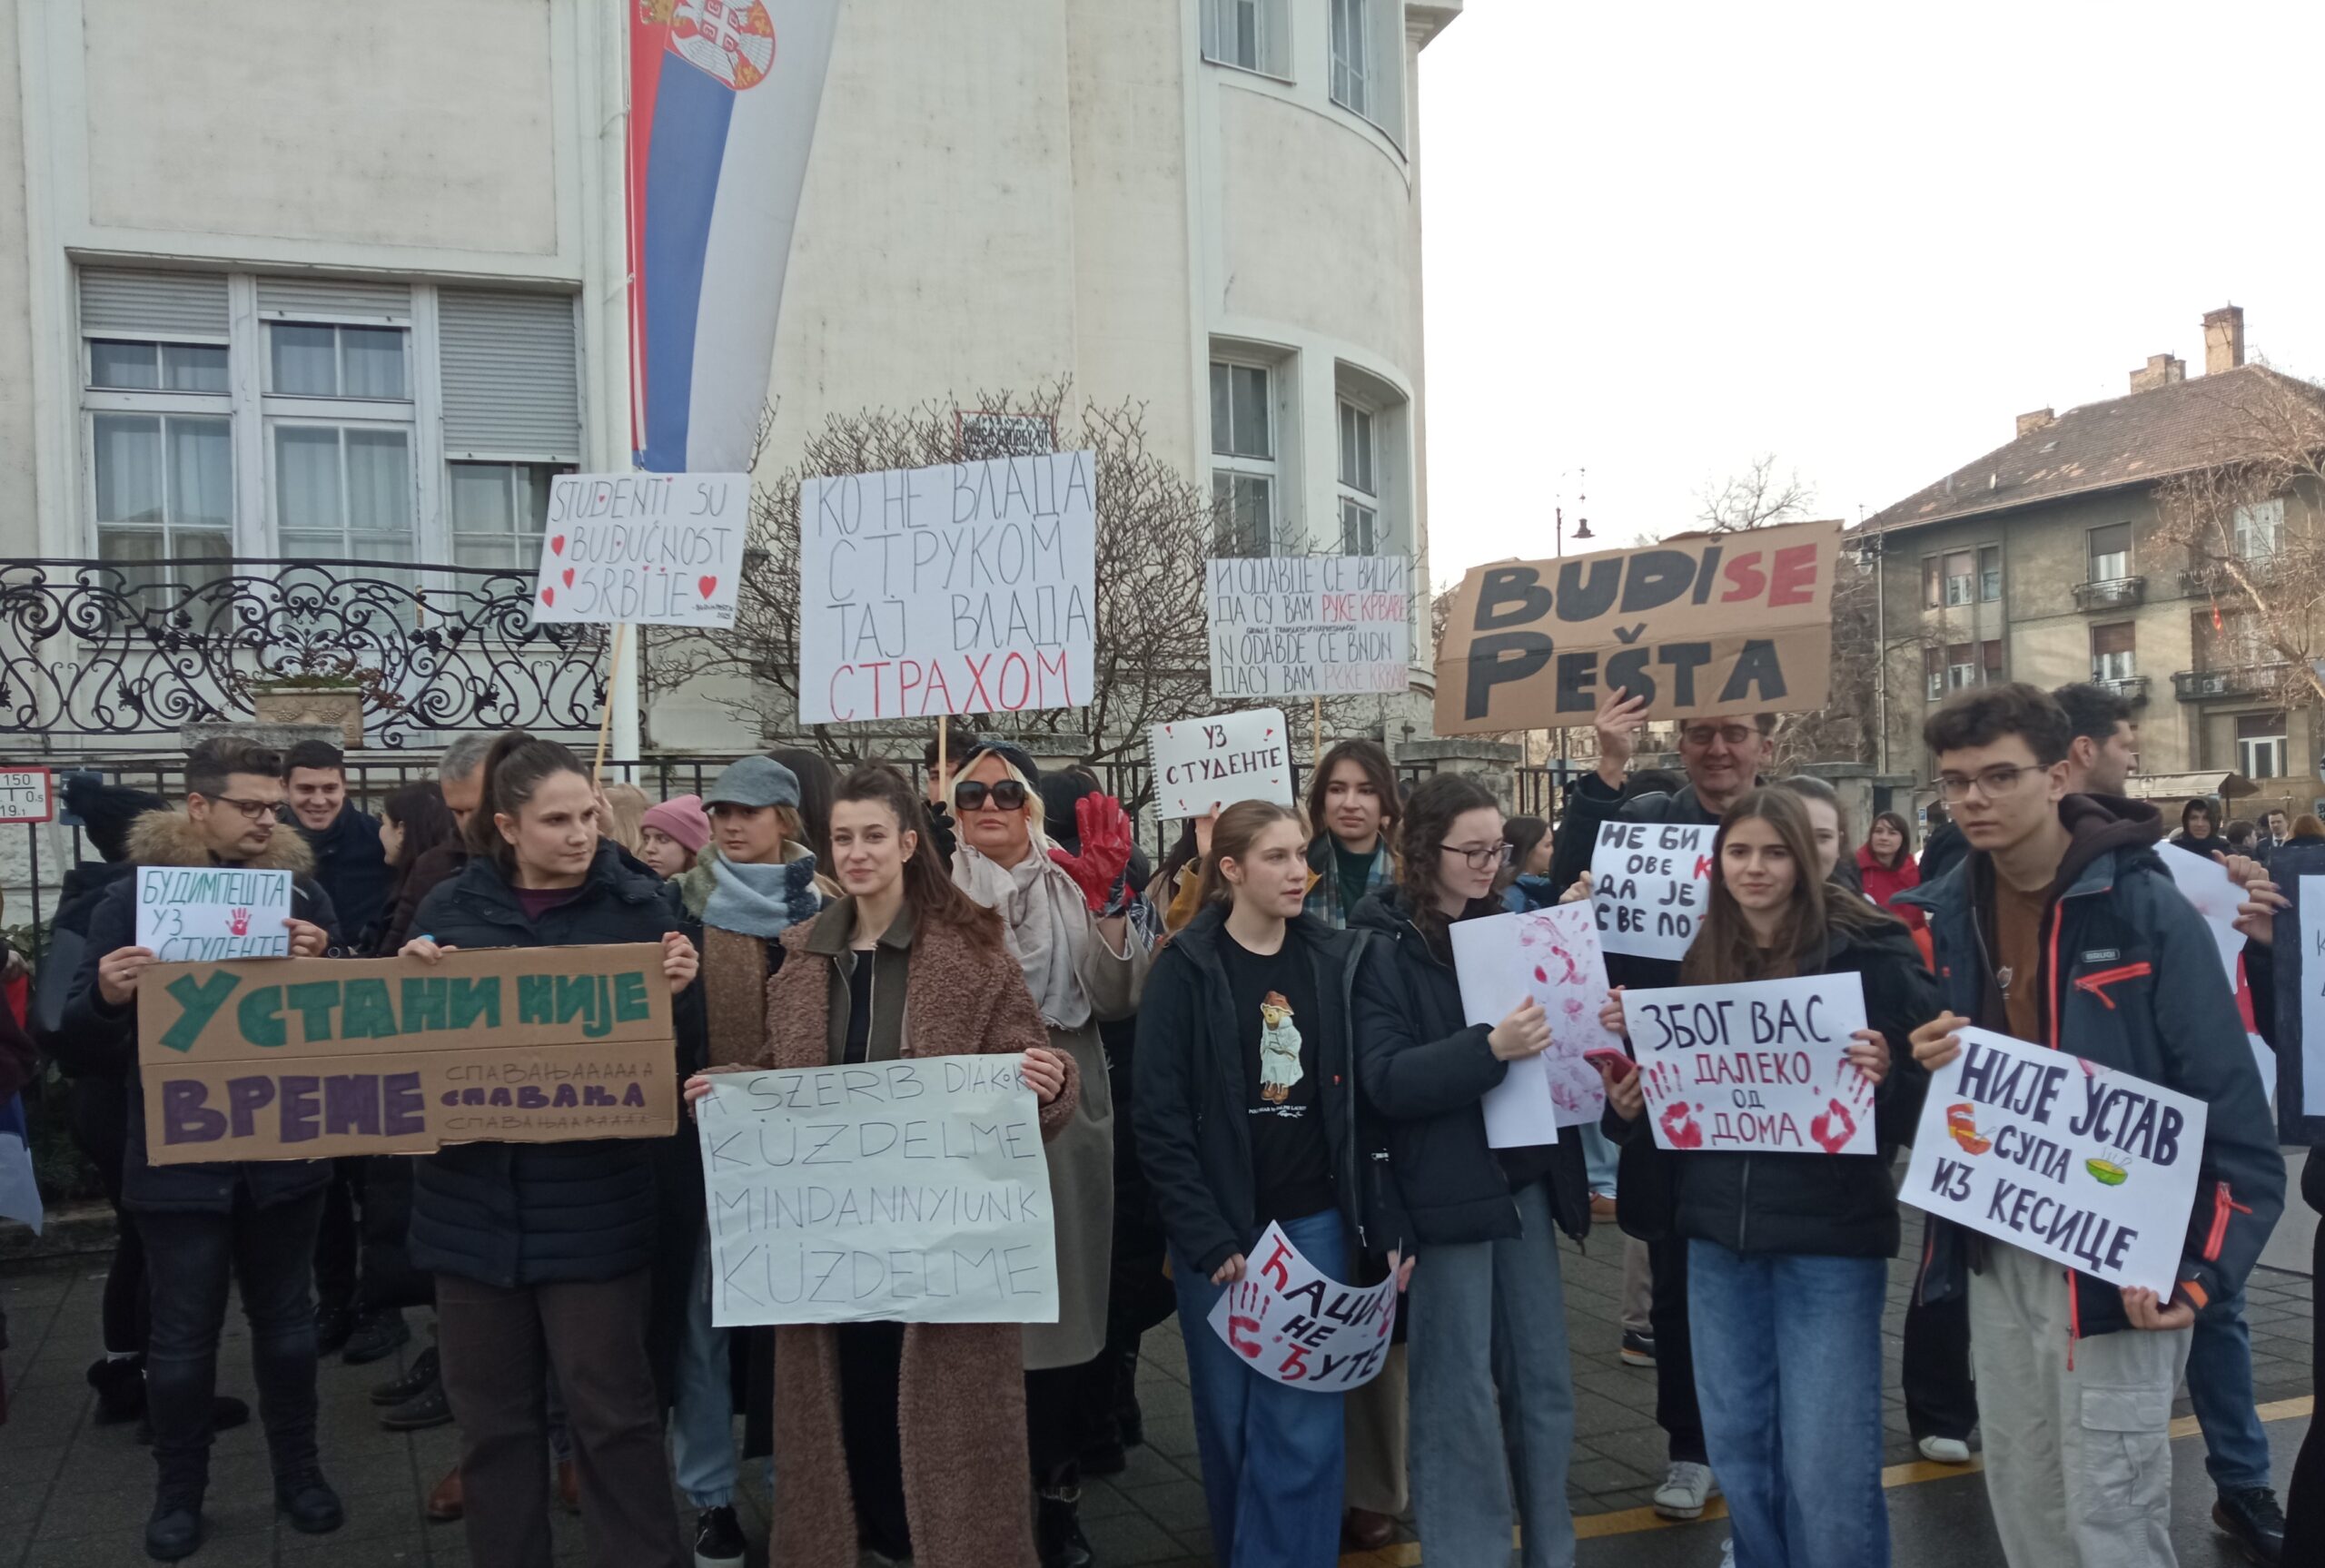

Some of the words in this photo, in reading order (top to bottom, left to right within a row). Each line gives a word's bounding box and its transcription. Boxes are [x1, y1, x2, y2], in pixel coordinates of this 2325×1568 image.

[689, 481, 727, 518] SU
[819, 475, 862, 537] КО
[883, 465, 928, 530] НЕ
[953, 451, 1092, 524] ВЛАДА
[829, 520, 1065, 602] СТРУКОМ
[1214, 557, 1233, 595] И
[1239, 557, 1314, 596] ОДАВДЕ
[1323, 557, 1344, 591] СЕ
[1358, 557, 1403, 593] ВИДИ
[826, 595, 906, 661] ТАЈ
[952, 585, 1091, 650] ВЛАДА
[1214, 596, 1246, 626] ДА
[1254, 596, 1272, 624] СУ
[1283, 596, 1314, 624] ВАМ
[1321, 594, 1357, 623] РУКЕ
[830, 648, 1073, 722] СТРАХОМ
[1283, 665, 1316, 694] ВАМ
[1464, 623, 1788, 721] PEŠTA
[1202, 725, 1228, 750] УЗ
[3, 774, 31, 785] 150
[1166, 746, 1282, 784] СТУДЕНТЕ
[1601, 823, 1647, 850] НЕ
[1658, 825, 1700, 852] БИ
[1627, 853, 1672, 876] ОВЕ
[143, 870, 285, 907] БУДИМПЕШТА
[1594, 873, 1637, 900] ДА
[1657, 880, 1696, 906] ЈЕ
[151, 909, 183, 936] УЗ
[1595, 902, 1647, 933] СВЕ
[158, 936, 287, 962] СТУДЕНТЕ
[158, 969, 501, 1053] УСТАНИ
[516, 971, 651, 1038] НИЈЕ
[1640, 1001, 1734, 1050] ЗБОГ
[1750, 994, 1833, 1045] ВАС
[1693, 1050, 1812, 1085] ДАЛЕКО
[440, 1082, 646, 1109] СПАВАЊА
[748, 1065, 924, 1111] SZERB
[1732, 1089, 1765, 1109] ОД
[1955, 1042, 2069, 1126] НИЈЕ
[2069, 1075, 2184, 1167] УСТАВ
[163, 1071, 425, 1146] ВРЕМЕ
[707, 1118, 1036, 1173] KÜZDELME
[1712, 1111, 1803, 1148] ДОМА
[1994, 1125, 2073, 1185] СУПА
[715, 1186, 1038, 1236] MINDANNYIUNK
[1929, 1157, 1975, 1202] ИЗ
[1986, 1178, 2139, 1273] КЕСИЦЕ
[720, 1242, 1042, 1312] KÜZDELME
[1281, 1314, 1337, 1348] НЕ
[1278, 1338, 1386, 1383] ЂУТЕ
